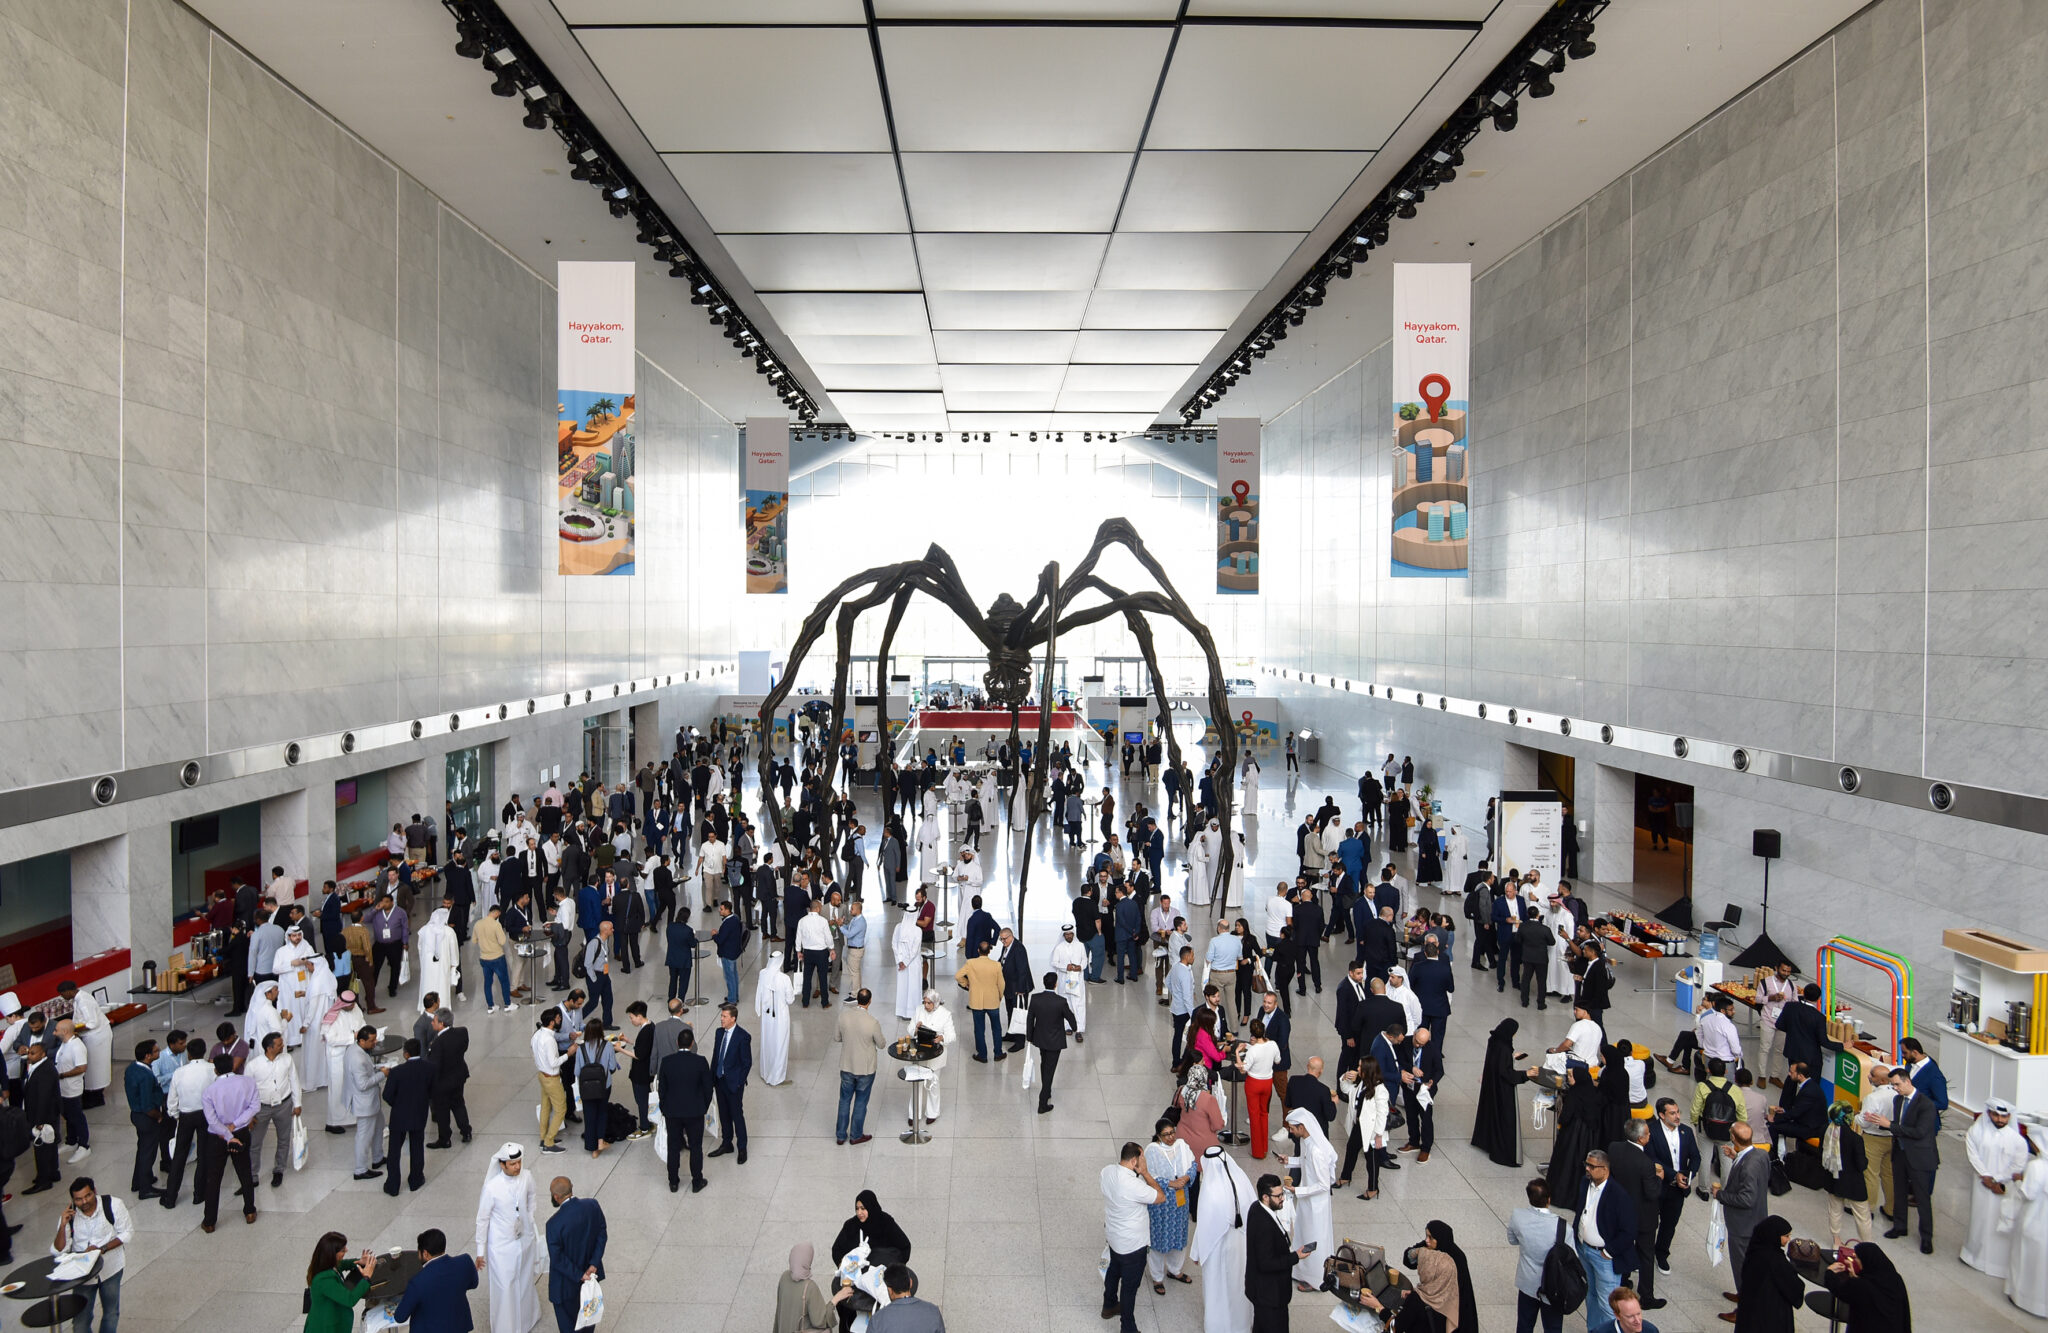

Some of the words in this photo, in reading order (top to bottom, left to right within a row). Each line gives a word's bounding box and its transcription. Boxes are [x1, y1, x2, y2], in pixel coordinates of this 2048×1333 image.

[568, 321, 624, 332] Hayyakom,
[1404, 321, 1460, 333] Hayyakom,
[581, 334, 612, 344] Qatar.
[1416, 334, 1448, 344] Qatar.
